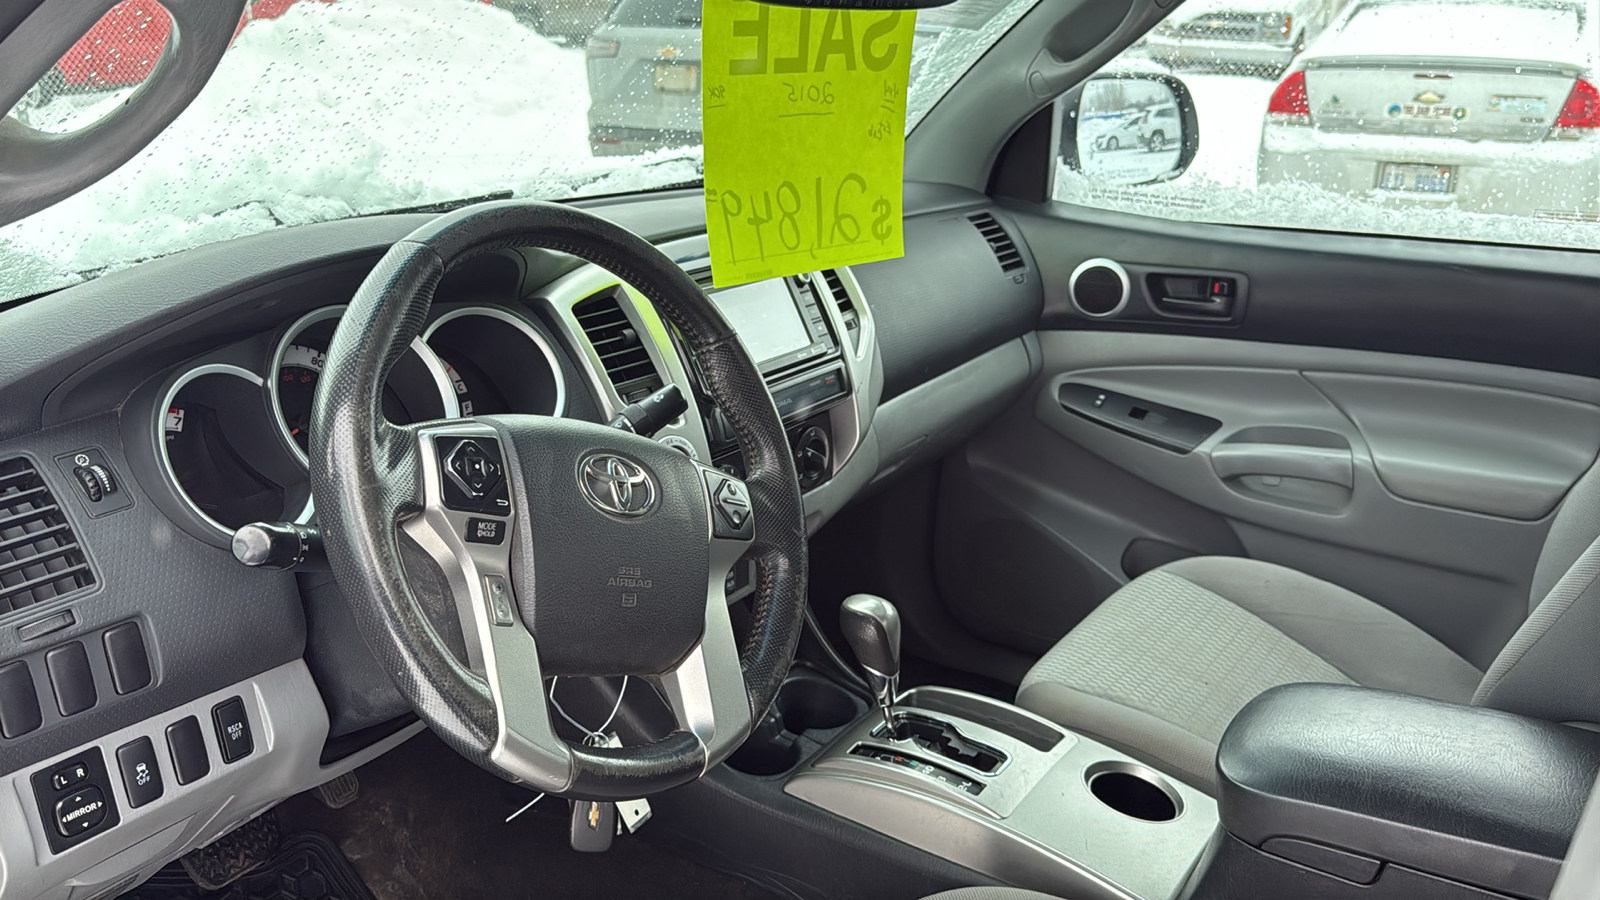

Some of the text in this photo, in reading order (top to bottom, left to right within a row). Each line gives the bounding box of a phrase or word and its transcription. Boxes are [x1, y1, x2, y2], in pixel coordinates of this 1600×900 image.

[311, 356, 324, 368] 80
[173, 416, 182, 427] 7
[477, 521, 498, 531] MODE
[607, 577, 652, 588] AIRBAG
[227, 721, 243, 735] RSCA
[231, 730, 242, 741] OFF
[76, 768, 85, 778] R
[60, 776, 68, 785] L
[137, 775, 151, 786] OFF
[66, 802, 97, 822] MIRROR
